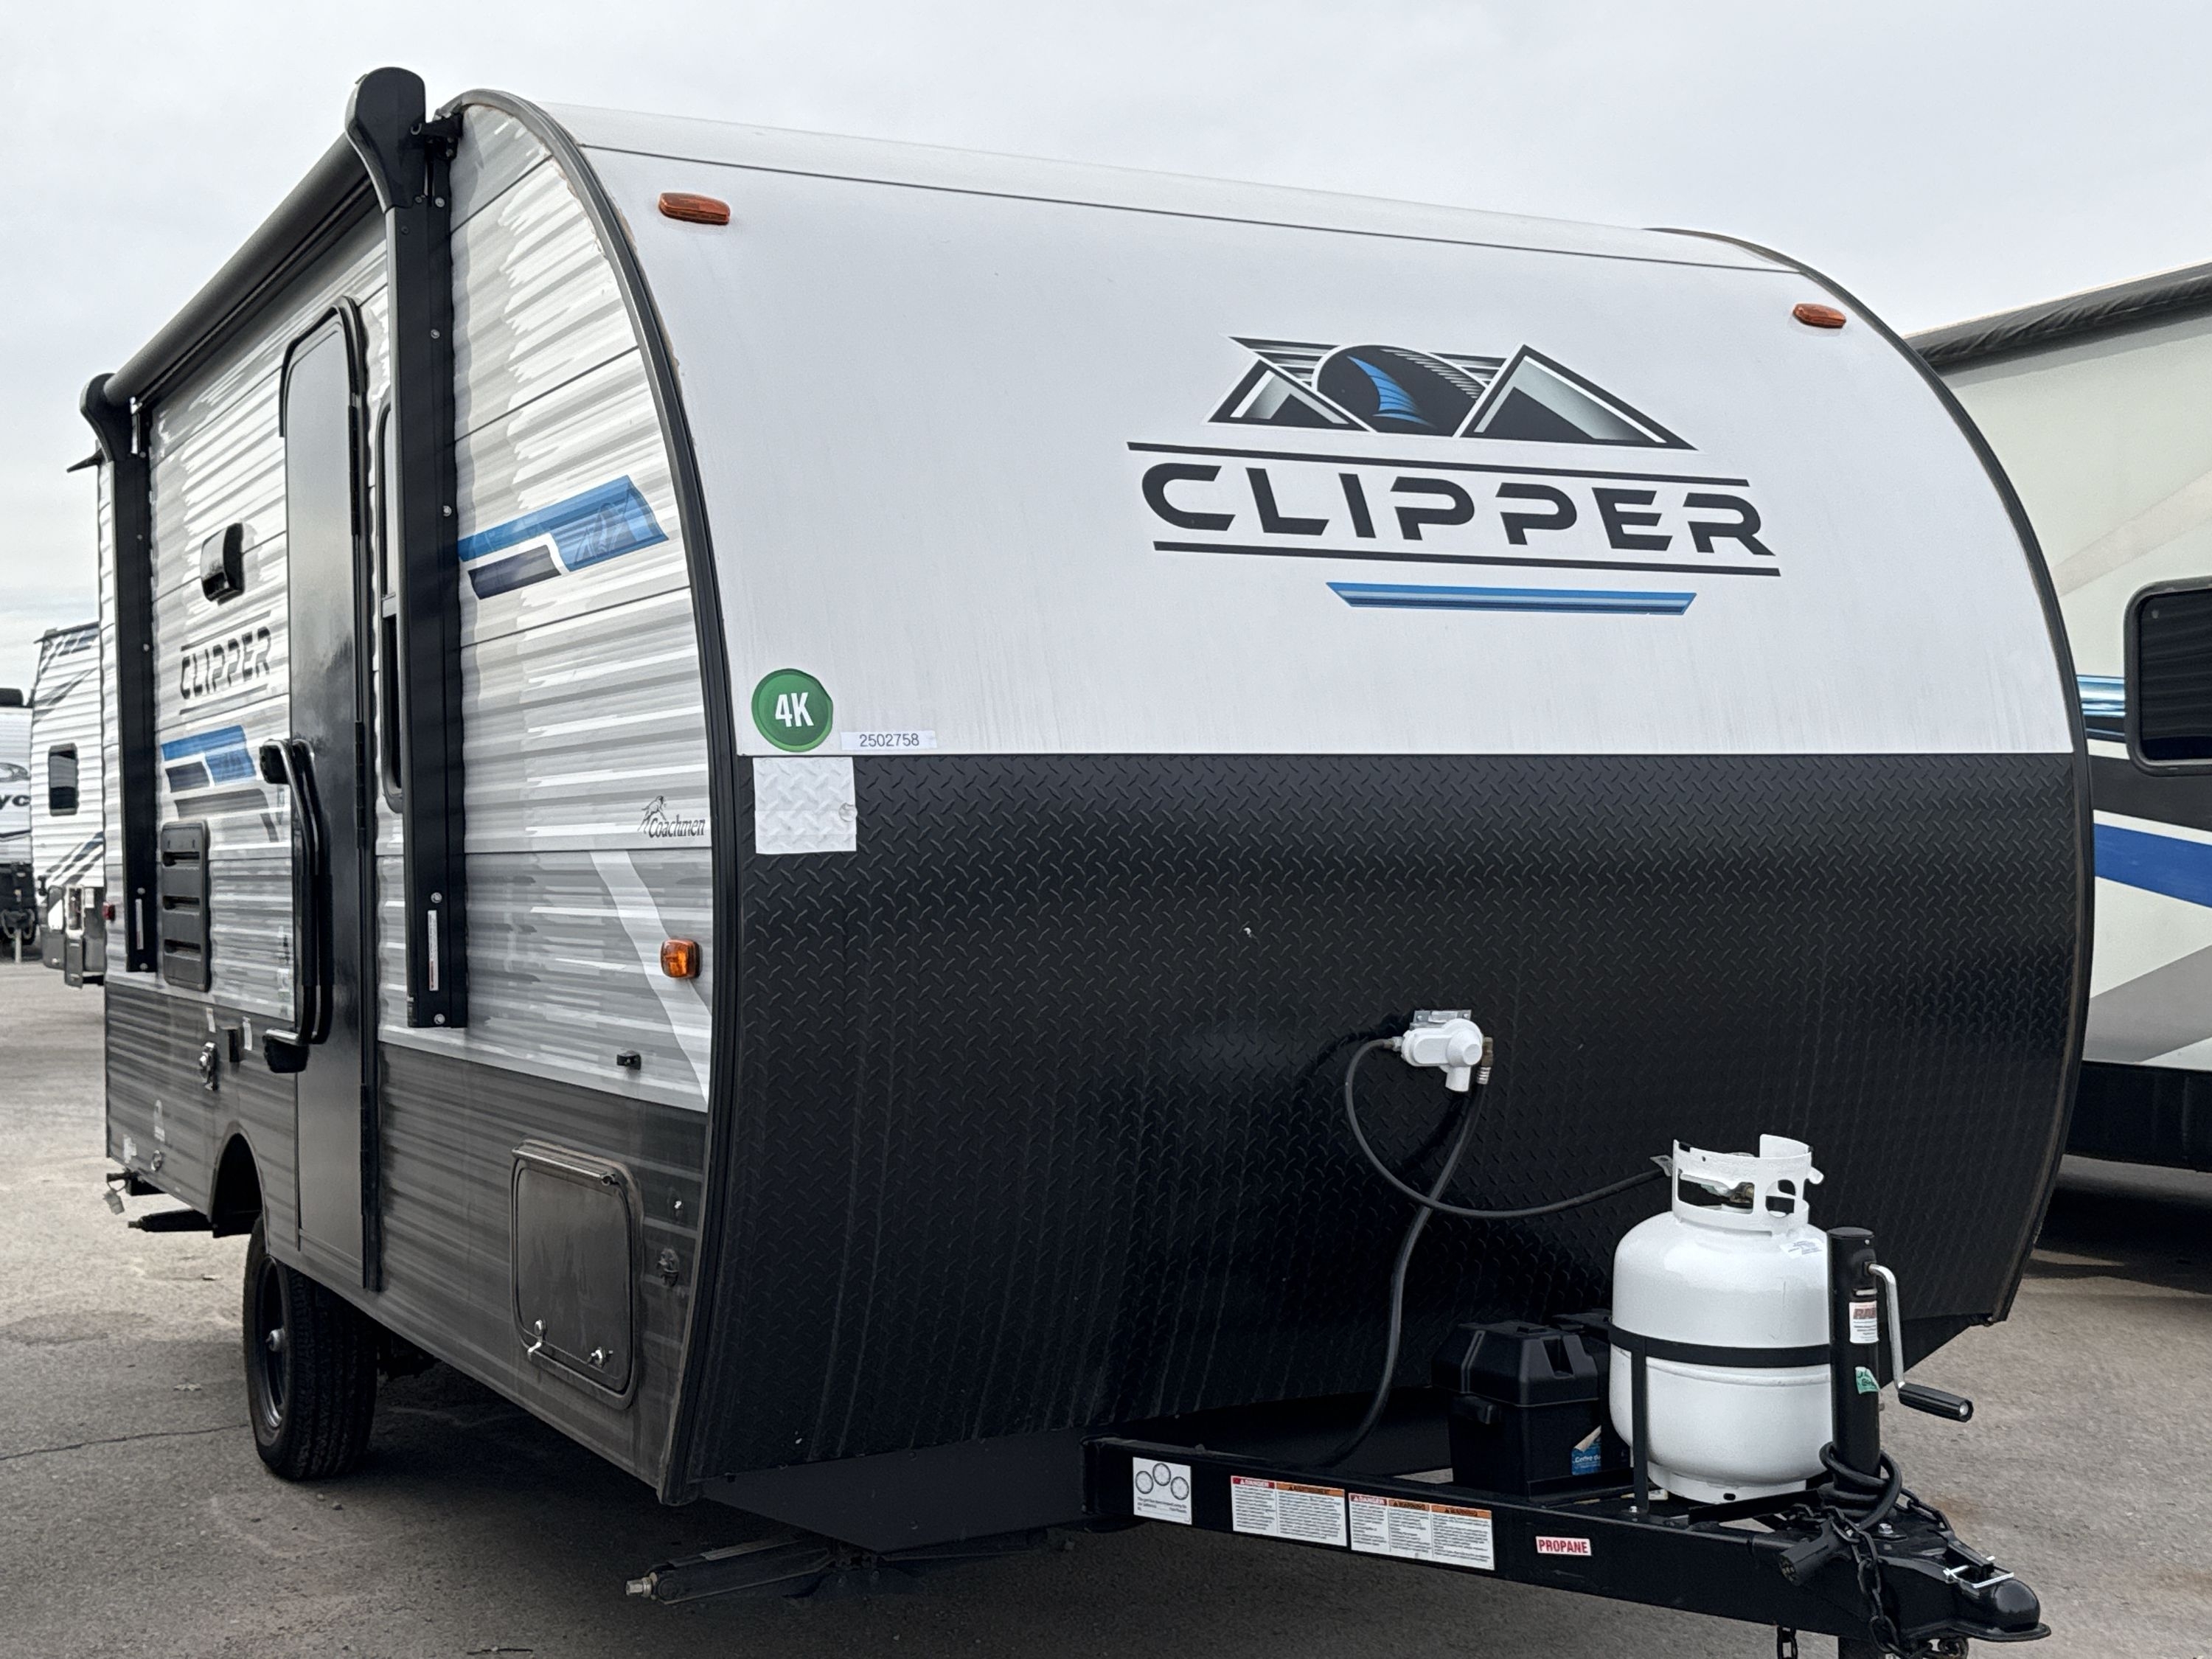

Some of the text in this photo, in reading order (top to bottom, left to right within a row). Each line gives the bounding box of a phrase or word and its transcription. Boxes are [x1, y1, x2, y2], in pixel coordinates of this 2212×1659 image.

[1141, 462, 1776, 557] CLIPPER
[180, 626, 271, 700] CLIPPER
[775, 692, 815, 728] 4K
[859, 733, 920, 747] 2502758
[649, 813, 706, 838] Coachmen
[1538, 1539, 1588, 1554] PROPANE
